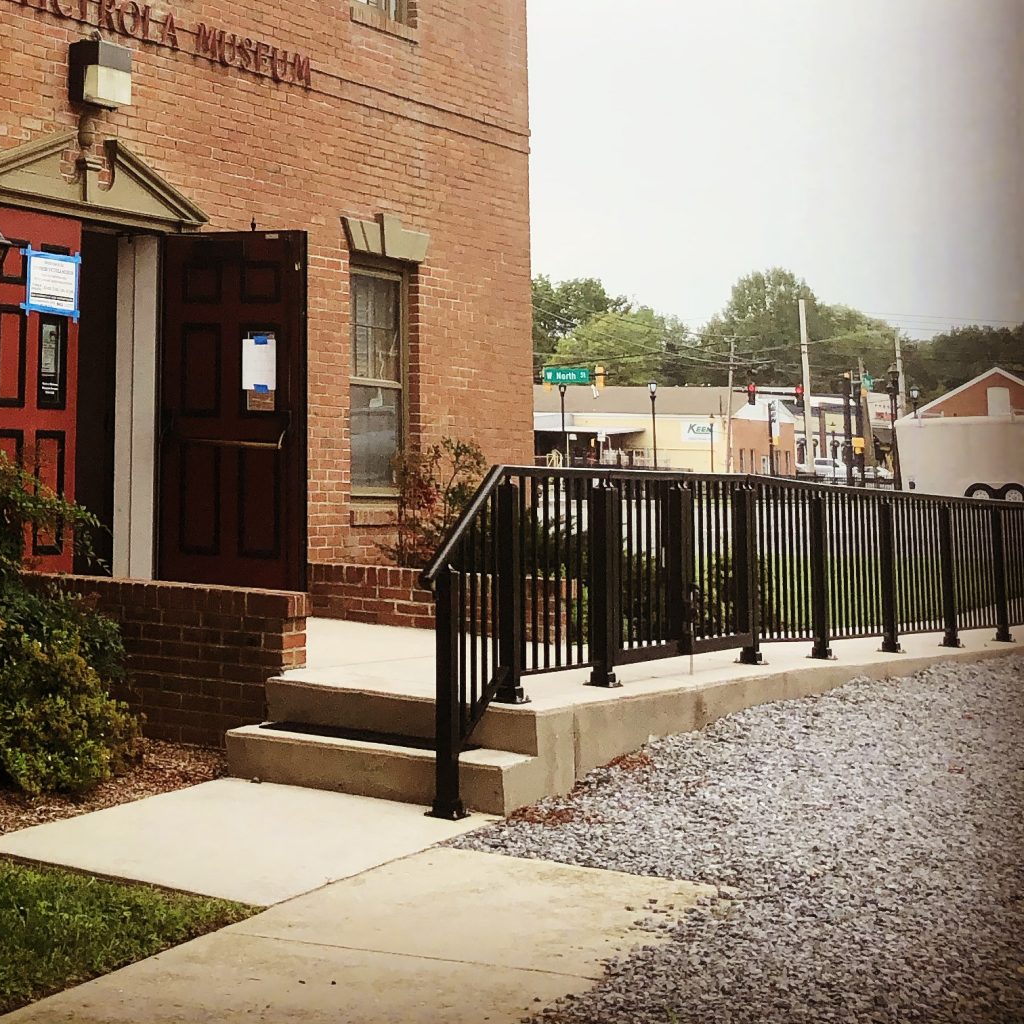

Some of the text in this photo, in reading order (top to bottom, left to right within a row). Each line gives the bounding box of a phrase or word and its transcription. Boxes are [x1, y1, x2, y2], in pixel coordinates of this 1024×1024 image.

[195, 22, 312, 86] MUSEUM
[546, 371, 553, 380] W
[556, 371, 577, 380] North
